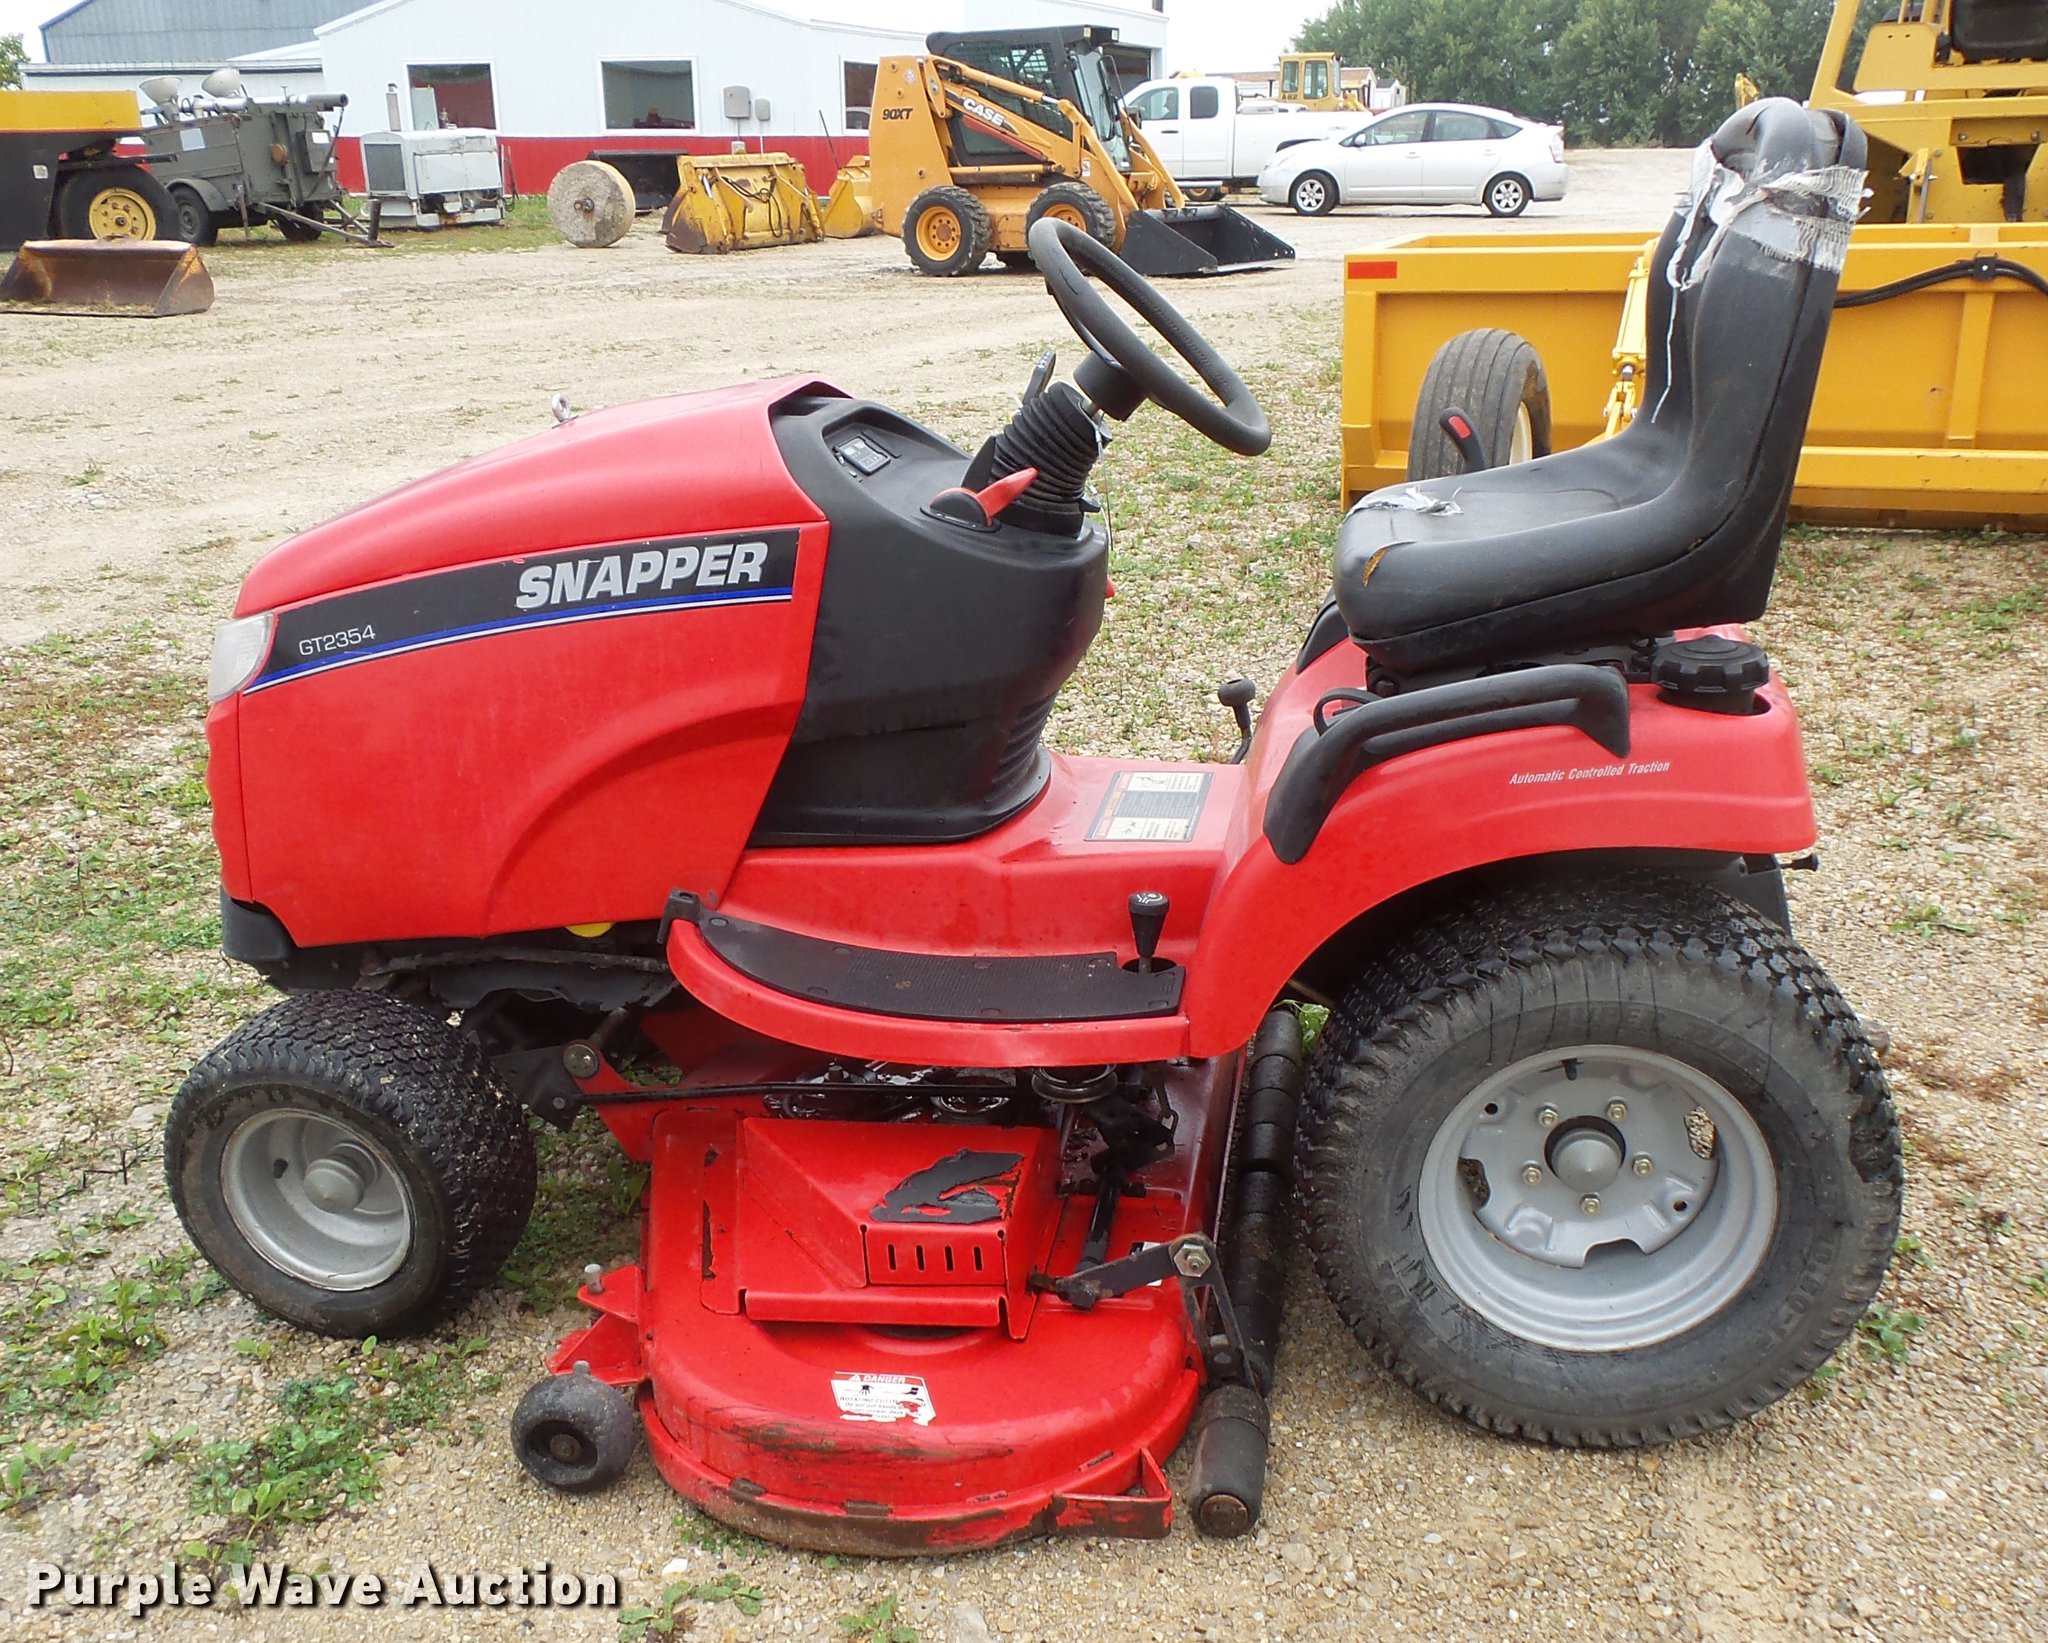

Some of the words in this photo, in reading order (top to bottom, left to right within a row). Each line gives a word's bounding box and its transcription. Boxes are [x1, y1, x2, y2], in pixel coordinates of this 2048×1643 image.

[882, 108, 913, 120] 90XT
[963, 97, 1005, 126] CASE
[515, 541, 768, 610] SNAPPER
[298, 624, 376, 656] GT2354
[1509, 770, 1565, 785] Automatic
[1568, 764, 1625, 781] Controlled
[1628, 761, 1671, 775] Traction
[863, 1374, 906, 1384] DANGER
